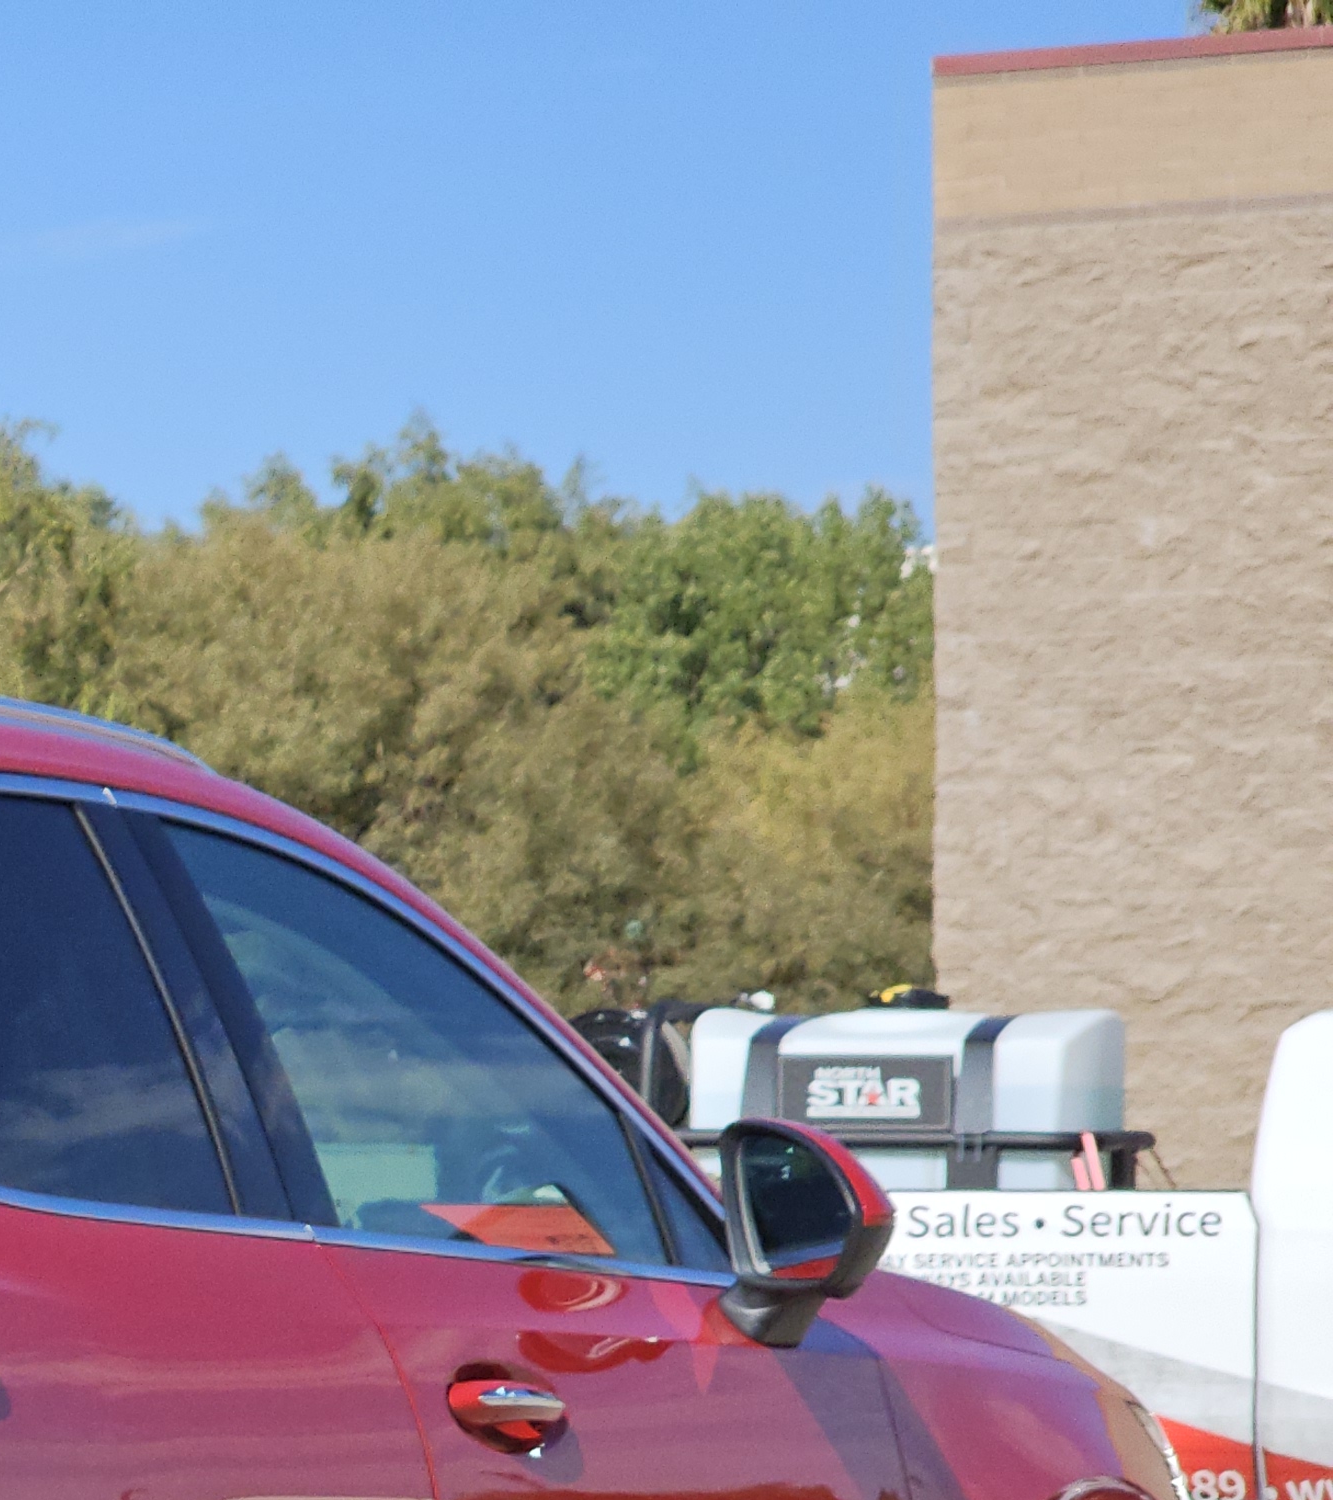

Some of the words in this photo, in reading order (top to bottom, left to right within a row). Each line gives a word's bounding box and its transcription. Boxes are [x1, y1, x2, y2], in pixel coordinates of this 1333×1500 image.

[806, 1078, 921, 1106] STAR
[906, 1203, 1020, 1239] Sales
[1060, 1202, 1223, 1238] Service
[913, 1253, 999, 1268] SERVICE
[1005, 1252, 1170, 1268] APPOINTMENTS
[977, 1271, 1087, 1287] AVAILABLE
[1001, 1290, 1087, 1307] MODELS
